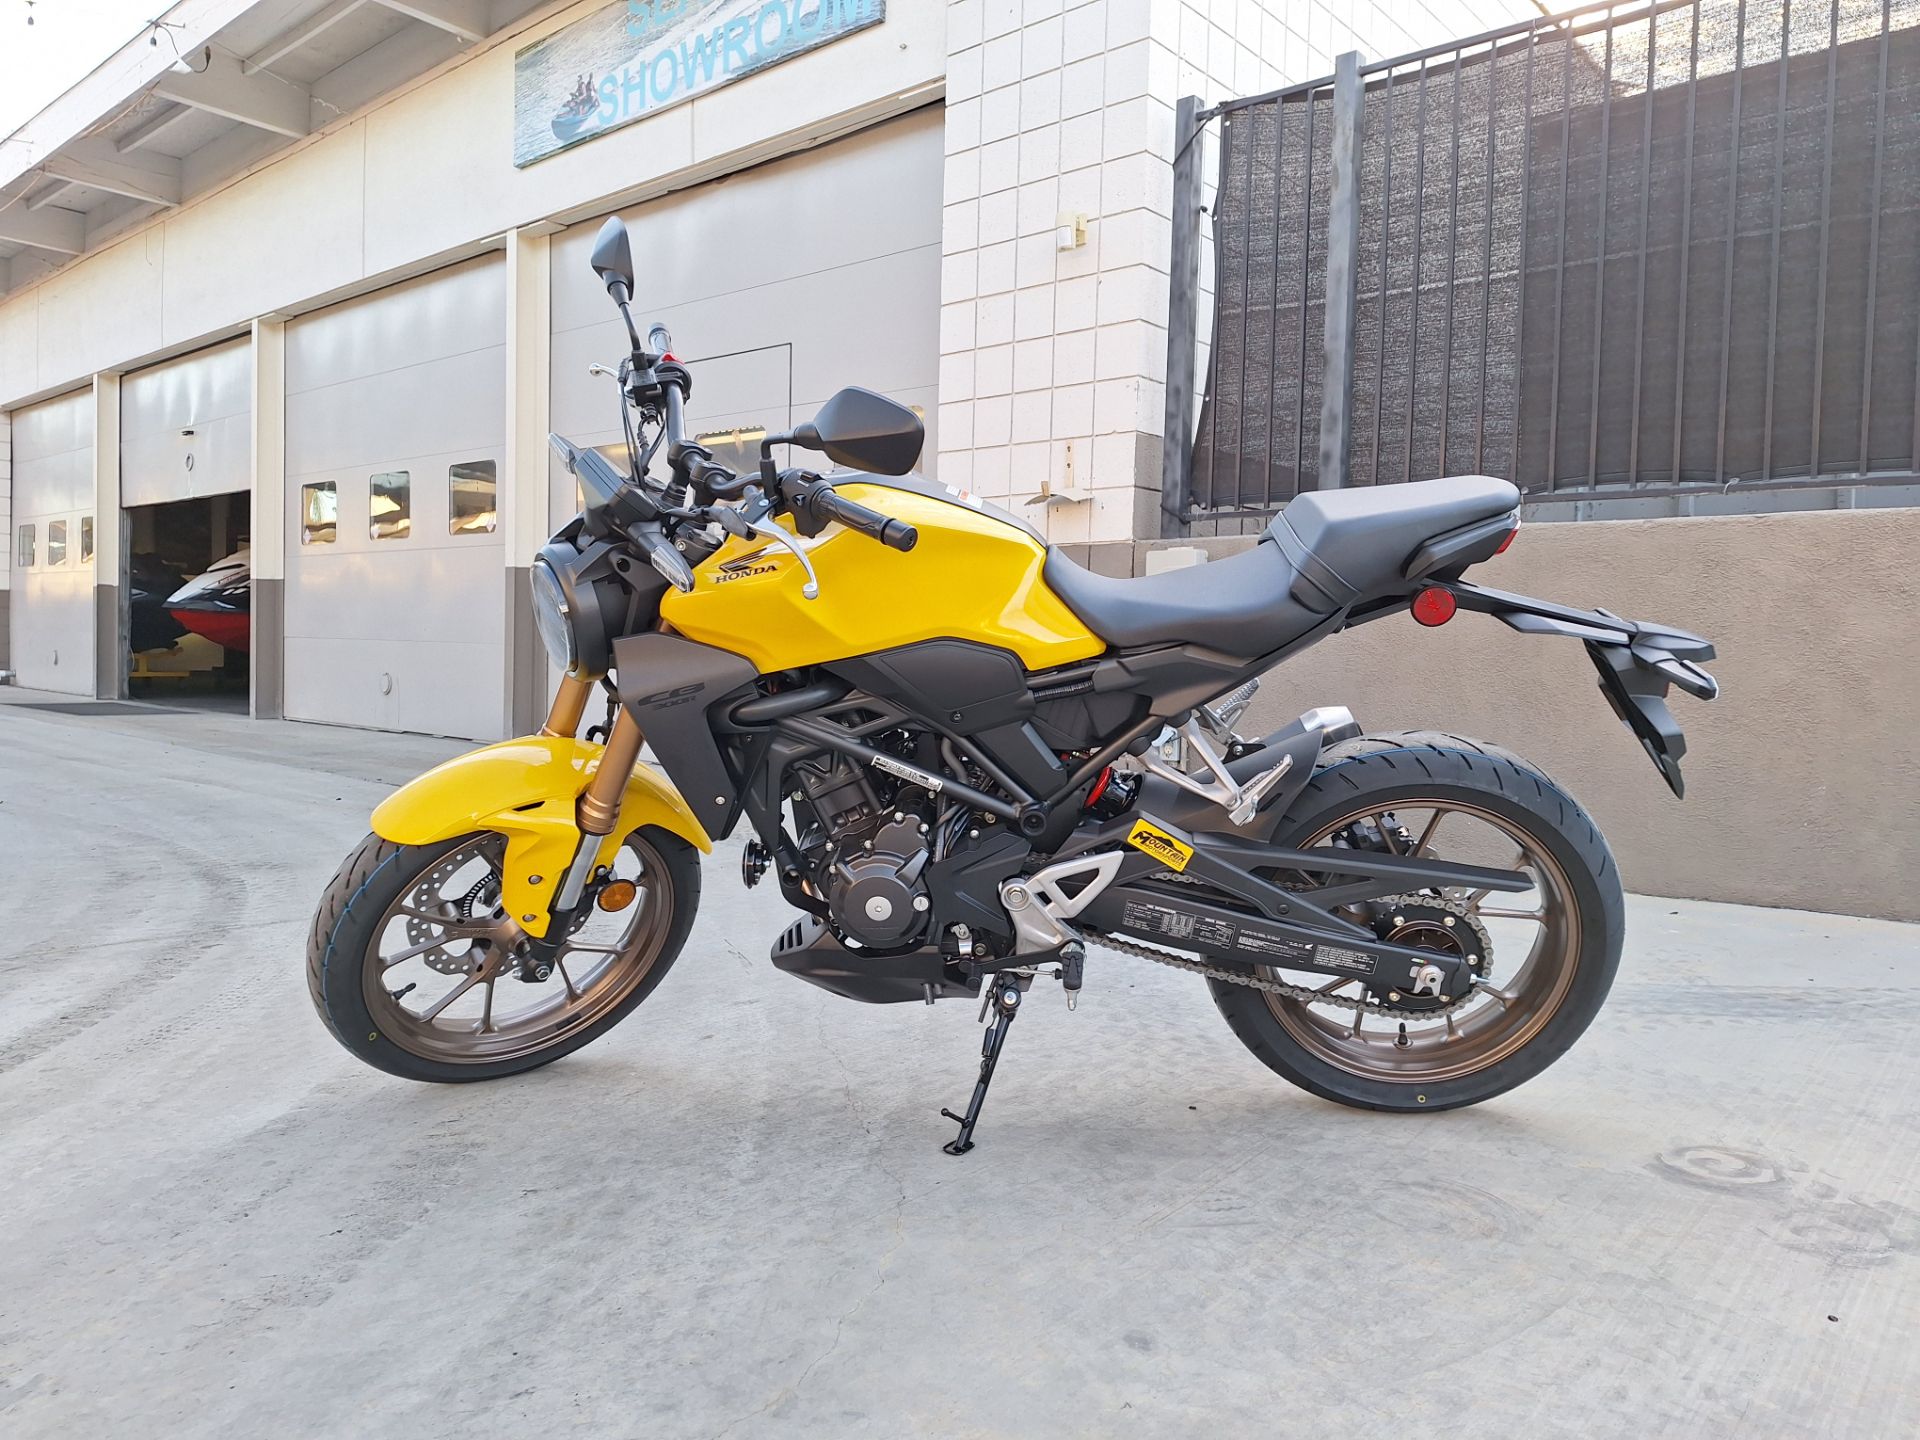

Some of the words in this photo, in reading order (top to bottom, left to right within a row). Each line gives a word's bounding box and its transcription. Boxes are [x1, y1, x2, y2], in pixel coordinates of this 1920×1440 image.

[598, 0, 868, 125] SHOWROOM
[715, 565, 778, 584] HONDA
[638, 682, 705, 706] CB
[1132, 831, 1187, 863] MOUNTAIN
